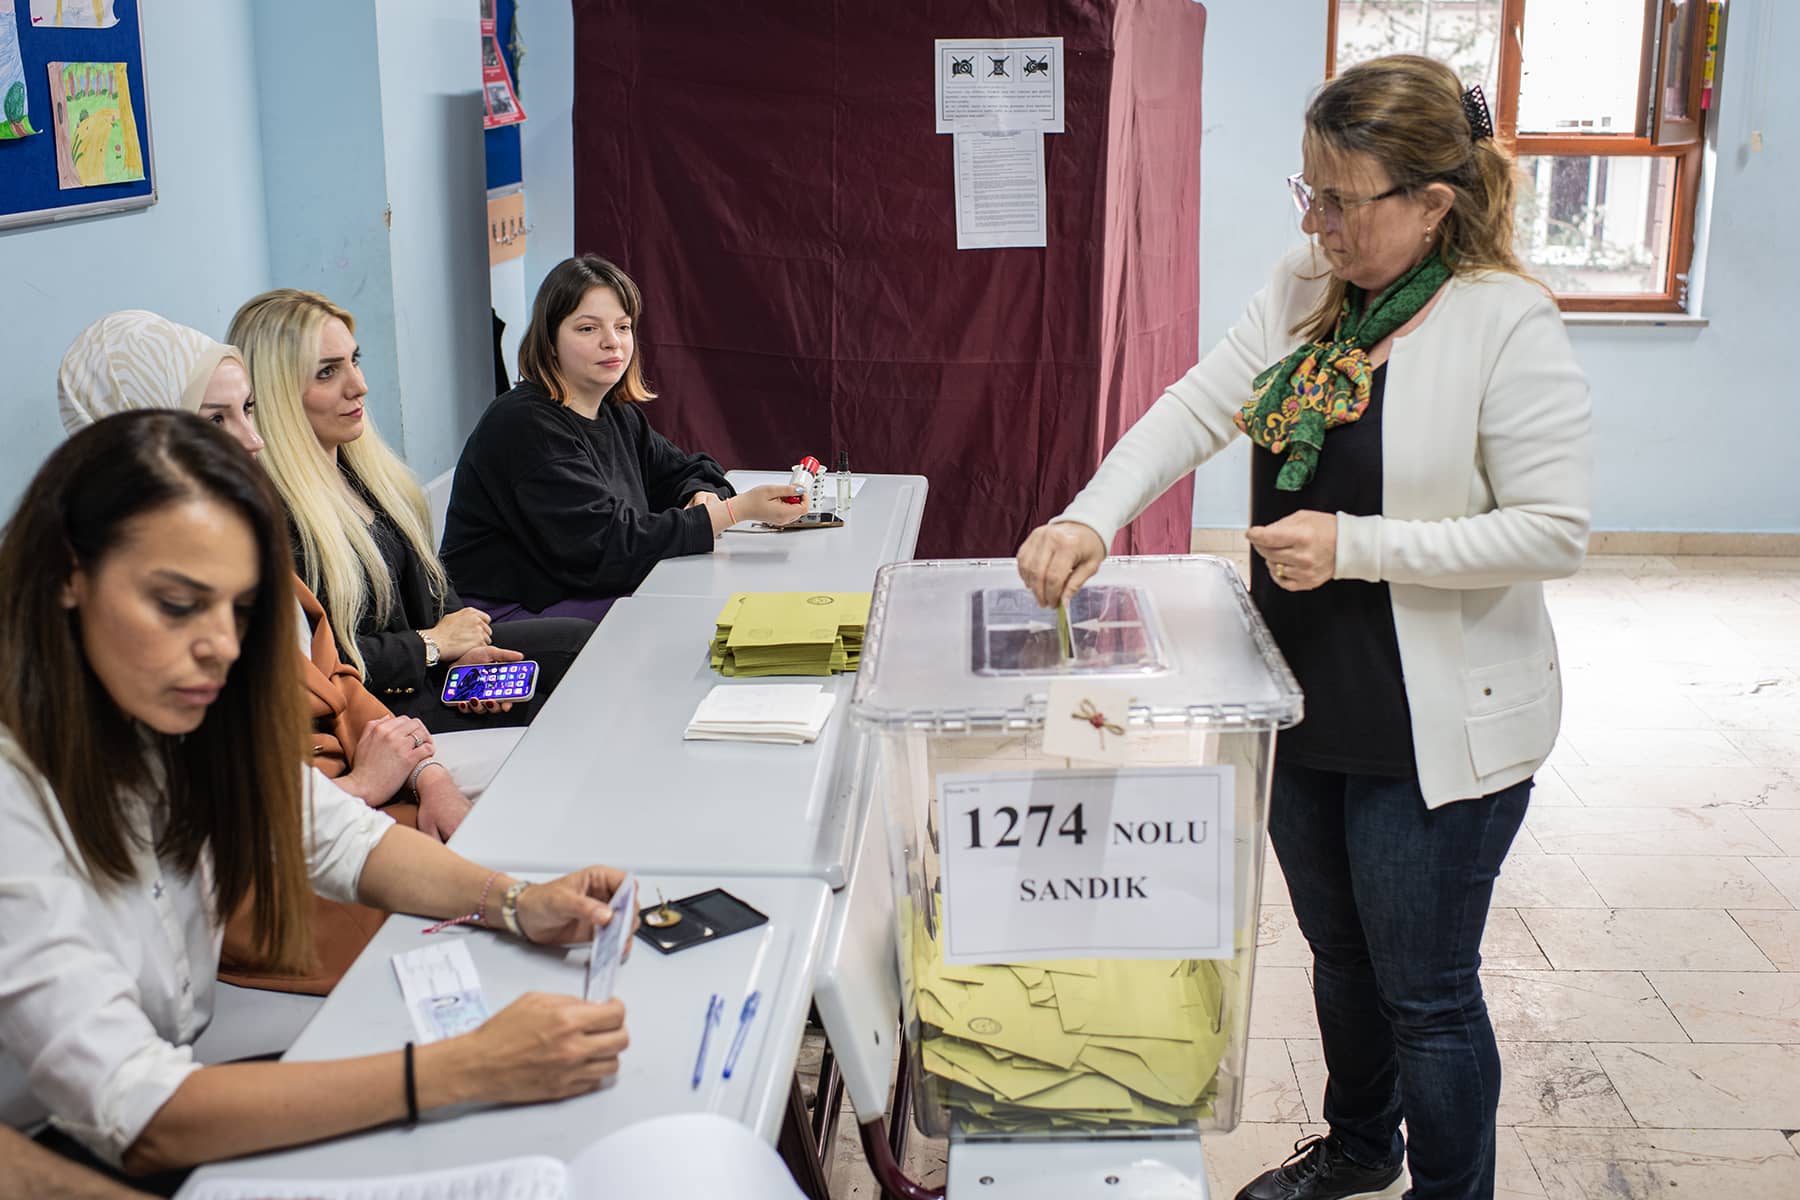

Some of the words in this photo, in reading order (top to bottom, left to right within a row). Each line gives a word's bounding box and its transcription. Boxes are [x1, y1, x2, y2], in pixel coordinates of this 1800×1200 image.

[963, 803, 1087, 849] 1274
[1113, 821, 1207, 845] NOLU
[1020, 876, 1149, 902] SANDIK
